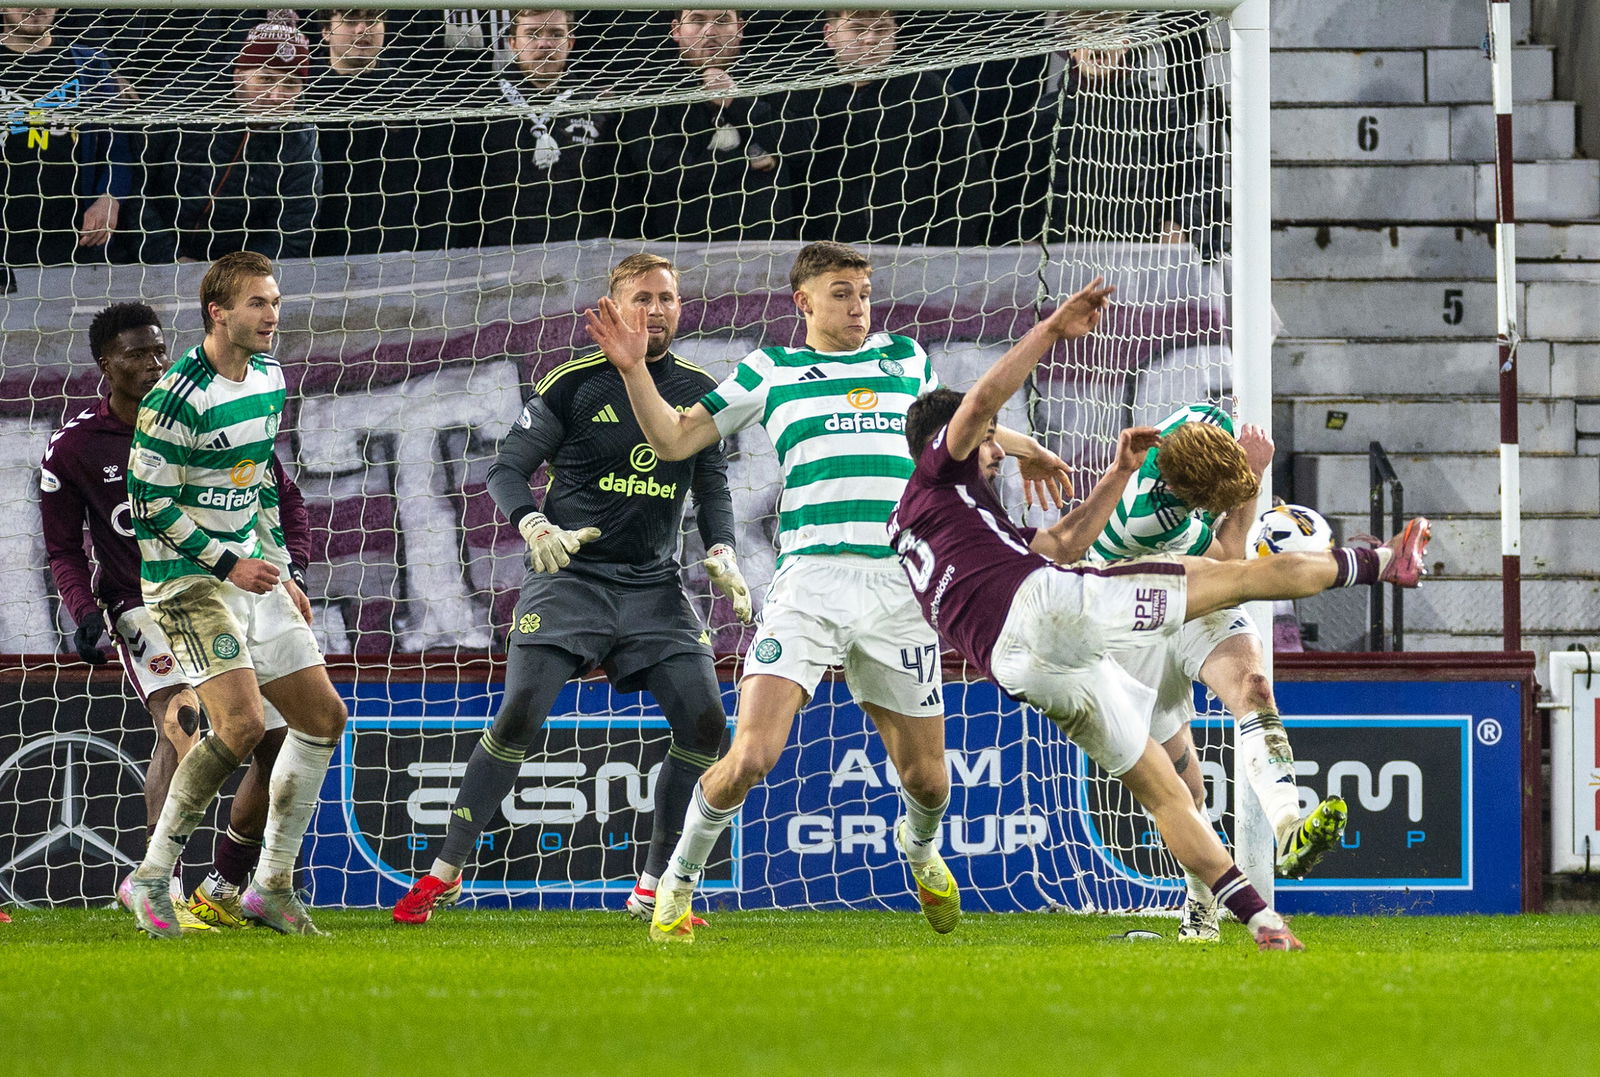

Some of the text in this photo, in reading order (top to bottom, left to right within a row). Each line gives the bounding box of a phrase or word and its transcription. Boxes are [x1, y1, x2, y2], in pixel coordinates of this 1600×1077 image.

[1357, 116, 1379, 152] 6
[1443, 289, 1464, 325] 5
[599, 472, 677, 499] dafabet
[930, 564, 956, 625] oveholidays
[1132, 588, 1152, 631] PPE
[900, 643, 937, 683] 47
[407, 832, 630, 851] GROU
